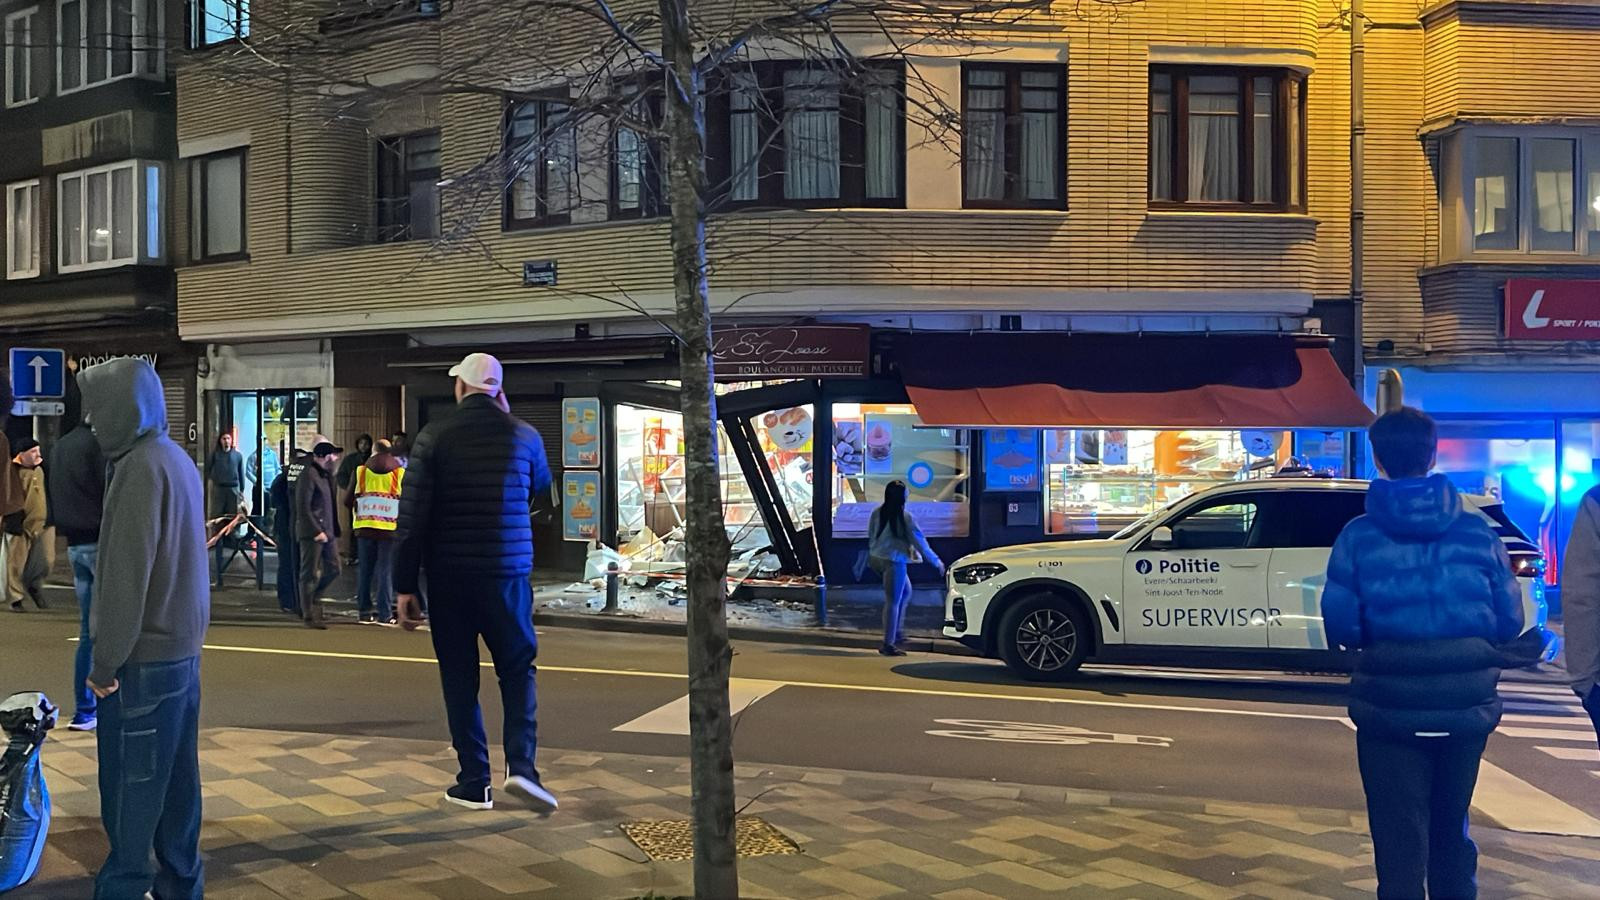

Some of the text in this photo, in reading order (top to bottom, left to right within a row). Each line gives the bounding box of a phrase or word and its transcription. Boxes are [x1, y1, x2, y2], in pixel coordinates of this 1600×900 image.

[738, 365, 805, 375] BOULANGERIE
[188, 422, 197, 441] 6
[1008, 503, 1019, 513] 63
[1159, 558, 1221, 573] Politie
[1142, 607, 1282, 627] SUPERVISOR
